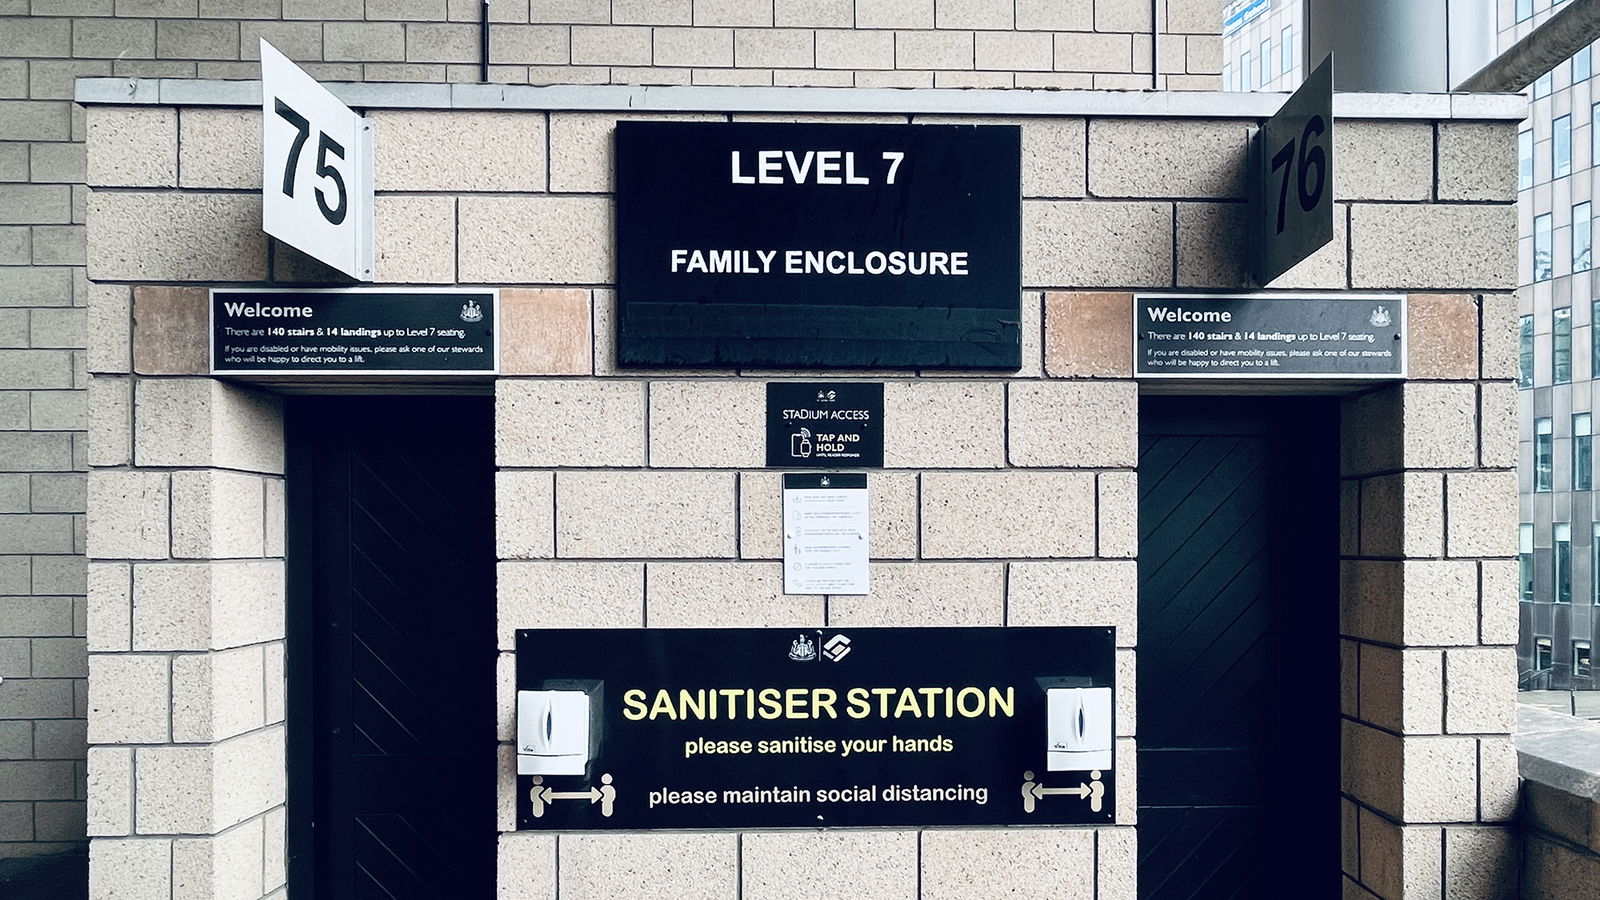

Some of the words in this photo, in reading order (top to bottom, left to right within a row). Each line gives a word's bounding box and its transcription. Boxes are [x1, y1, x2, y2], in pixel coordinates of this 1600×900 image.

[274, 96, 347, 226] 75
[731, 150, 870, 185] LEVEL
[882, 151, 904, 185] 7
[1271, 114, 1326, 236] 76
[671, 250, 776, 274] FAMILY
[785, 250, 968, 276] ENCLOSURE
[224, 302, 313, 318] Welcome
[1147, 307, 1232, 322] Welcome
[225, 327, 250, 336] There
[267, 327, 285, 336] 140
[287, 327, 315, 336] stairs
[316, 328, 324, 336] &
[326, 328, 338, 336] 14
[340, 328, 382, 338] landings
[384, 330, 395, 338] up
[406, 328, 428, 336] Level
[430, 328, 436, 336] 7
[437, 329, 466, 339] seating.
[1147, 332, 1171, 340] There
[1188, 332, 1205, 340] 140
[1207, 332, 1233, 340] stairs
[1234, 332, 1241, 340] &
[1244, 332, 1255, 340] 14
[1257, 332, 1296, 342] landings
[1320, 332, 1340, 340] Level
[1341, 332, 1347, 340] 7
[320, 345, 348, 354] mobility
[782, 409, 828, 420] STADIUM
[830, 410, 870, 420] ACCESS
[837, 434, 860, 442] AND
[816, 444, 844, 452] HOLD
[622, 688, 838, 721] SANITISER
[846, 686, 1014, 720] STATION
[685, 736, 753, 758] please
[757, 736, 837, 754] sanitise
[841, 740, 887, 759] your
[892, 735, 953, 753] hands
[648, 787, 718, 809] please
[723, 786, 811, 804] maintain
[816, 785, 878, 803] social
[882, 784, 988, 806] distancing
